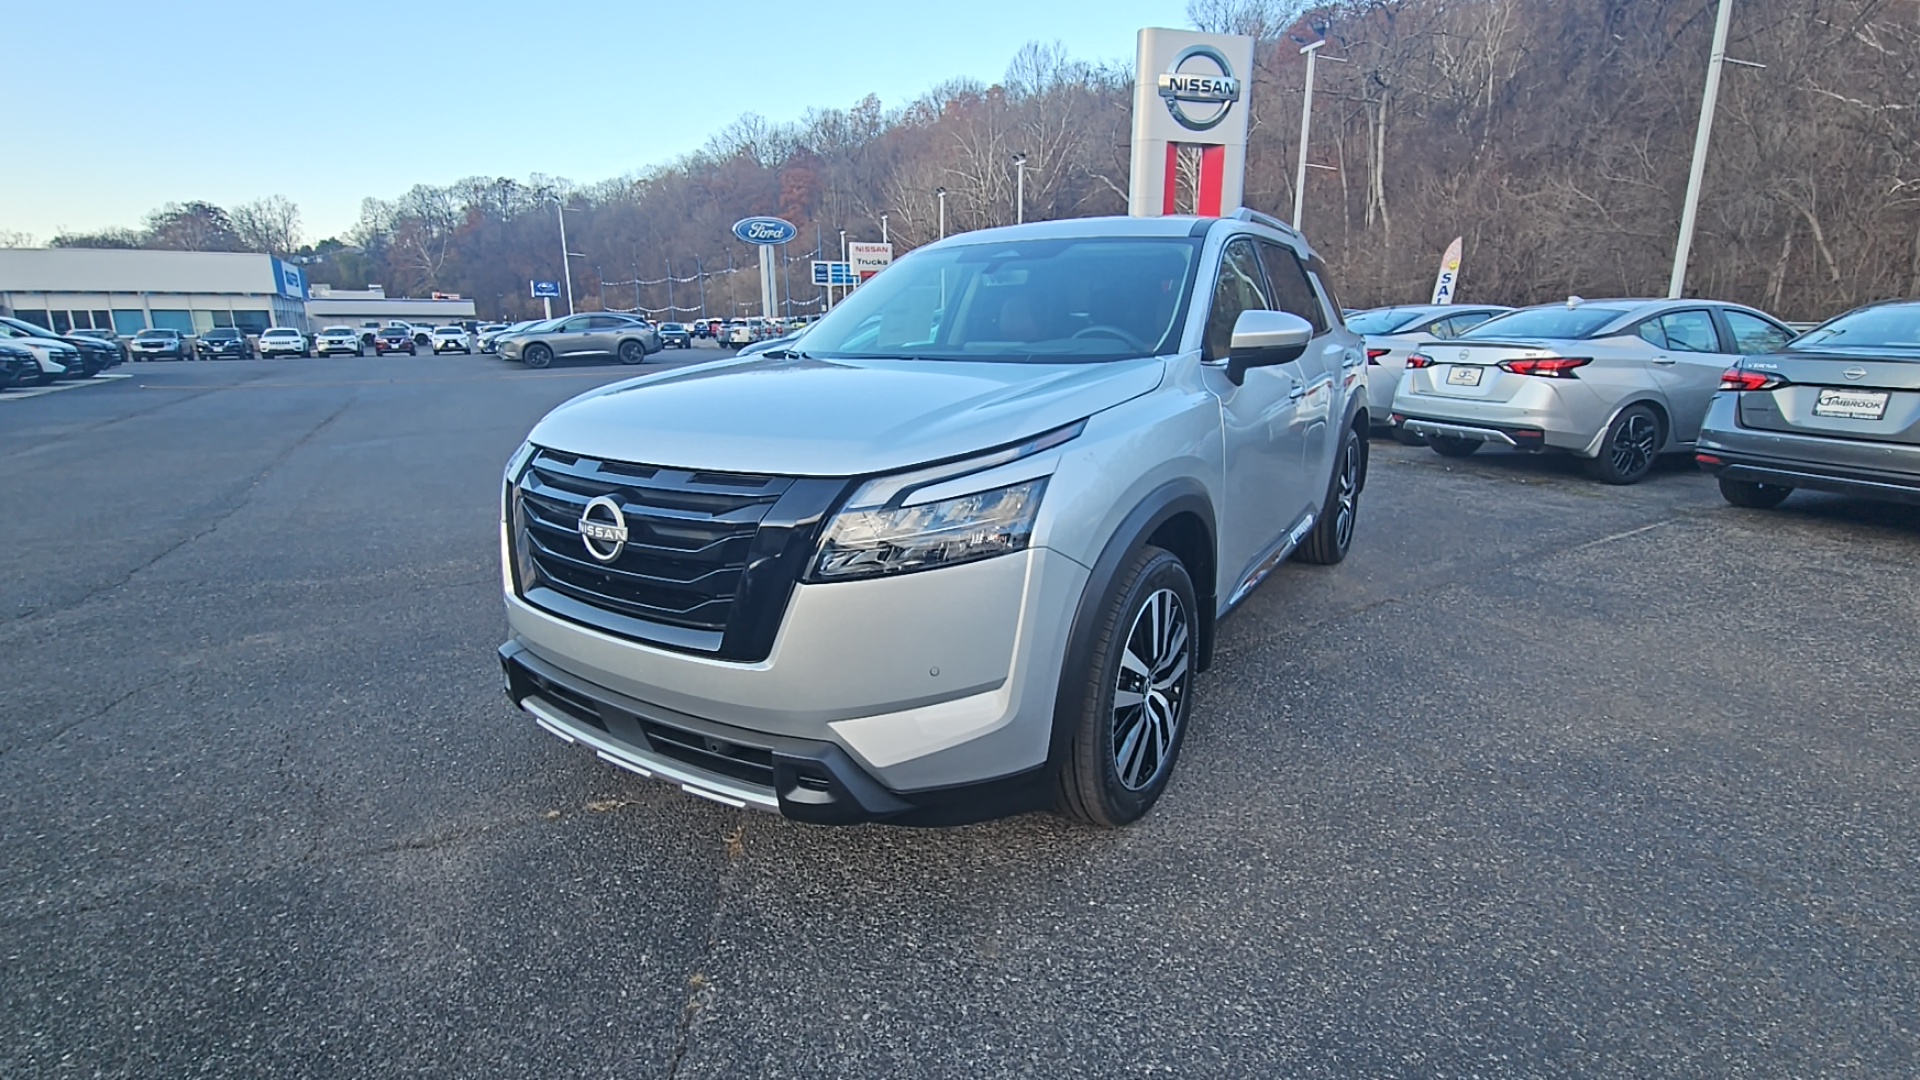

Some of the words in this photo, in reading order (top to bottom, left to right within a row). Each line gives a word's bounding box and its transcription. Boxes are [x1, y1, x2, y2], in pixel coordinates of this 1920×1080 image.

[1169, 78, 1235, 95] NISSAN
[748, 221, 785, 239] Ford
[856, 258, 888, 266] Trucks
[579, 521, 626, 541] NISSAN
